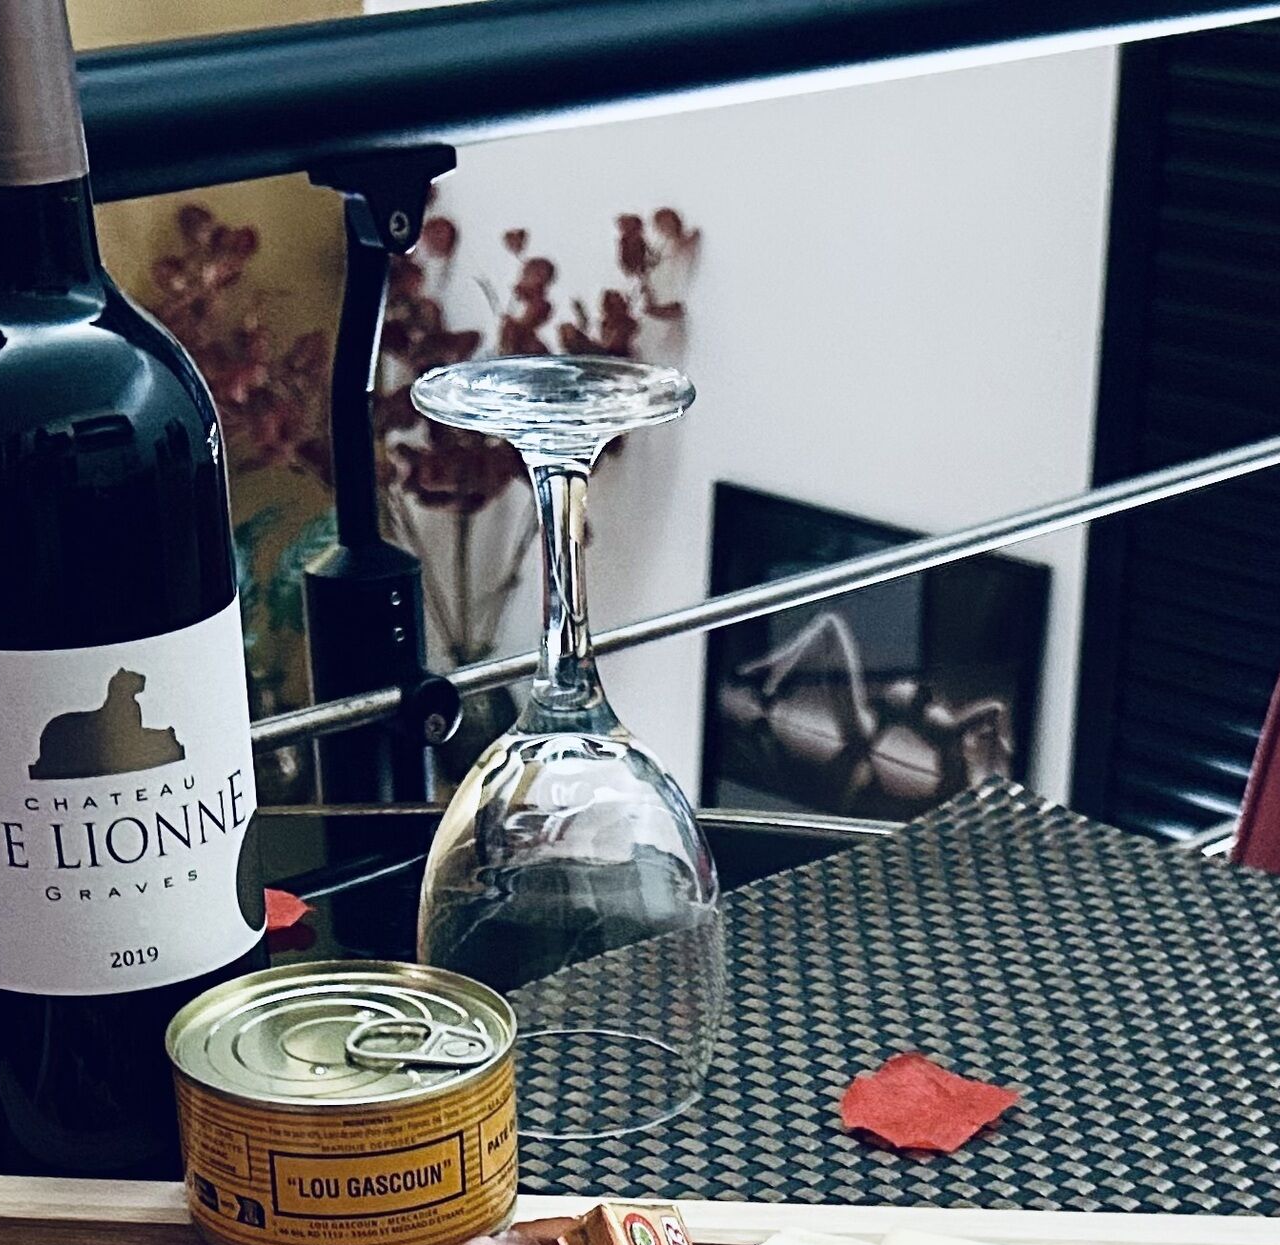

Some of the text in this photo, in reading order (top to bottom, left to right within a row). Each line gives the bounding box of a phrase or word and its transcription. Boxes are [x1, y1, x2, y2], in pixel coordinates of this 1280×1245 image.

[24, 775, 196, 811] CHATEAU
[51, 769, 247, 870] LIONNE
[45, 869, 199, 901] GRAVES
[110, 946, 160, 969] 2019
